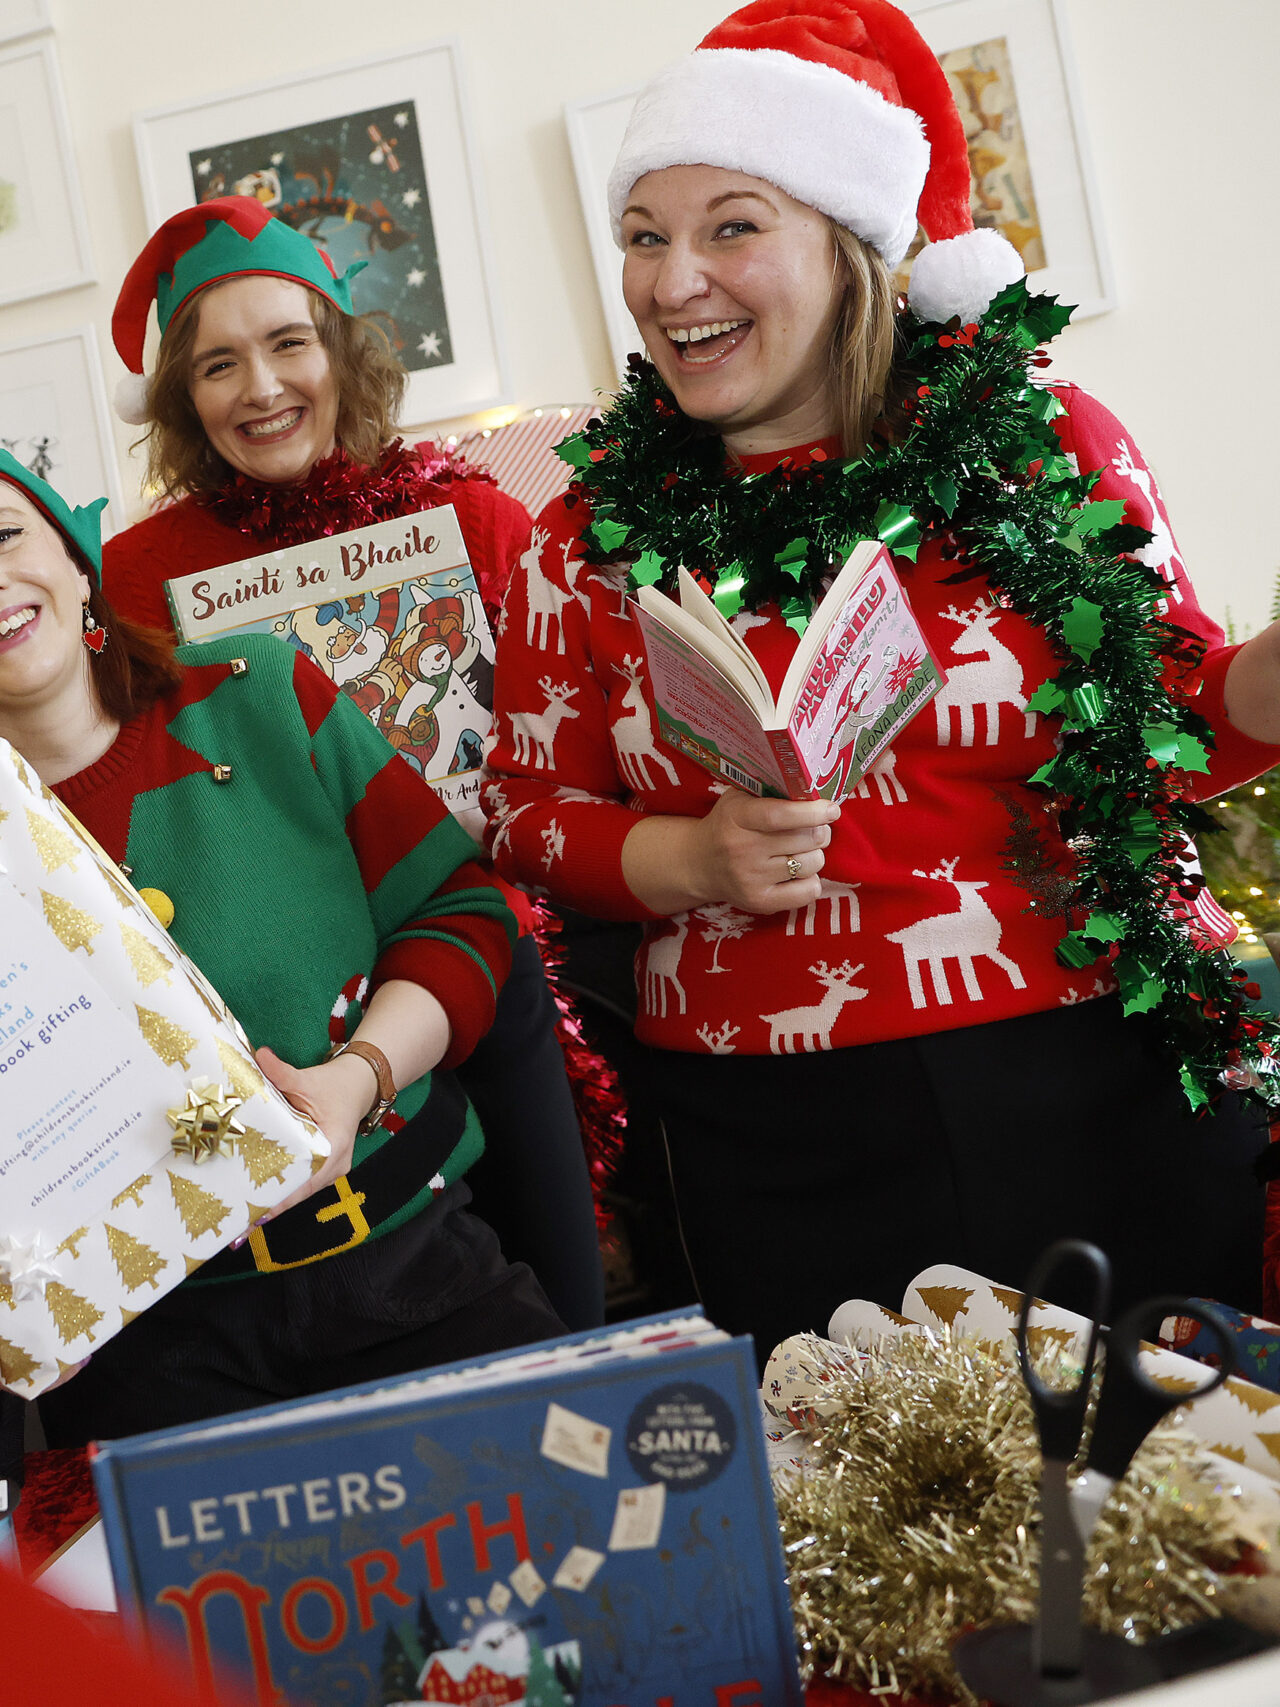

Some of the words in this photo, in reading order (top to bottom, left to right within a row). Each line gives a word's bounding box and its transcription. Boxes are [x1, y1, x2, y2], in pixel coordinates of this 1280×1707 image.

[295, 564, 331, 588] sa
[340, 525, 441, 582] Bhaile
[850, 591, 899, 667] Calamity
[856, 719, 891, 763] LEONA
[892, 667, 935, 717] FORDE
[900, 703, 918, 722] KAREN
[38, 994, 93, 1045] gifting
[16, 1117, 44, 1141] Please
[46, 1089, 77, 1117] contact
[32, 1145, 50, 1162] with
[51, 1132, 67, 1146] any
[67, 1104, 98, 1133] queries
[31, 1111, 143, 1208] childrensbooksireland.ie
[637, 1428, 723, 1456] SANTA
[156, 1465, 407, 1549] LETTERS
[156, 1492, 532, 1706] NORTH
